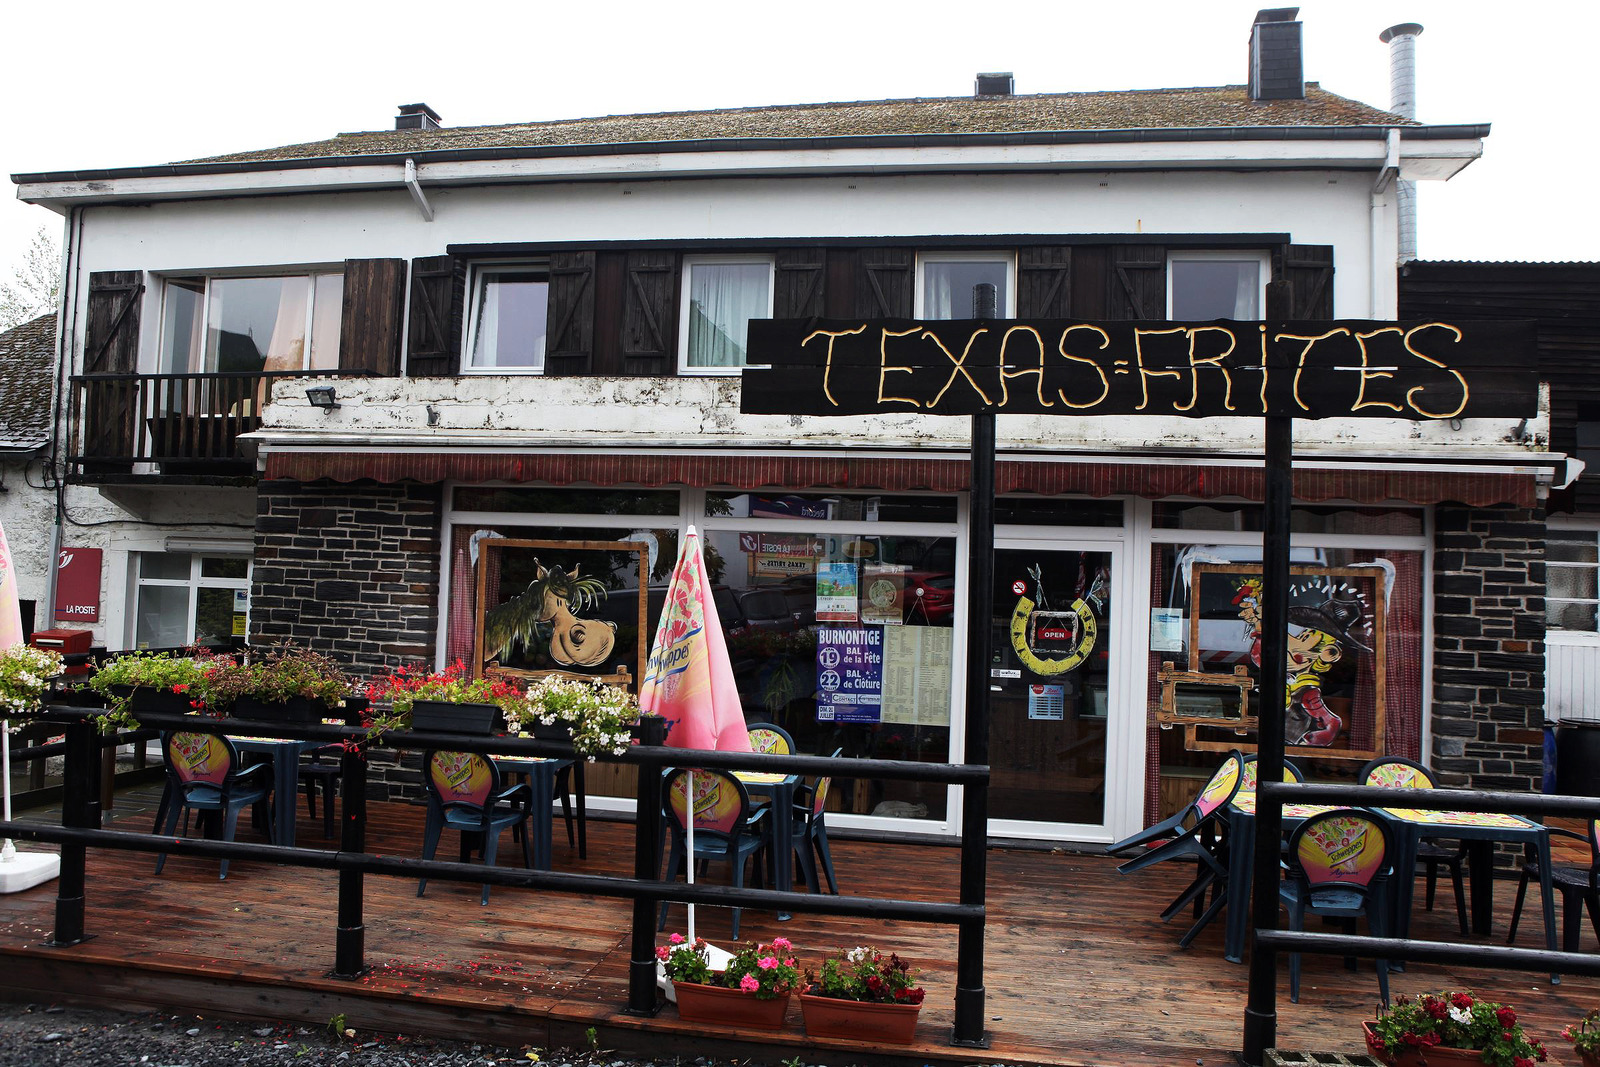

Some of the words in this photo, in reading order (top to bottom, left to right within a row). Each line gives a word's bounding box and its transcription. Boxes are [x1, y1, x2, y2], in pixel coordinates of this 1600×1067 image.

[66, 605, 74, 613] LA
[75, 605, 96, 614] POSTE
[819, 629, 880, 645] BURNONTIGE
[846, 647, 862, 655] BAL
[820, 652, 838, 664] 19
[843, 655, 853, 663] de
[855, 655, 862, 663] la
[864, 651, 880, 664] Fête
[846, 669, 861, 678] BAL
[821, 674, 838, 686] 22
[843, 680, 852, 689] de
[854, 677, 880, 689] Clôture
[1330, 839, 1363, 864] Schweppes
